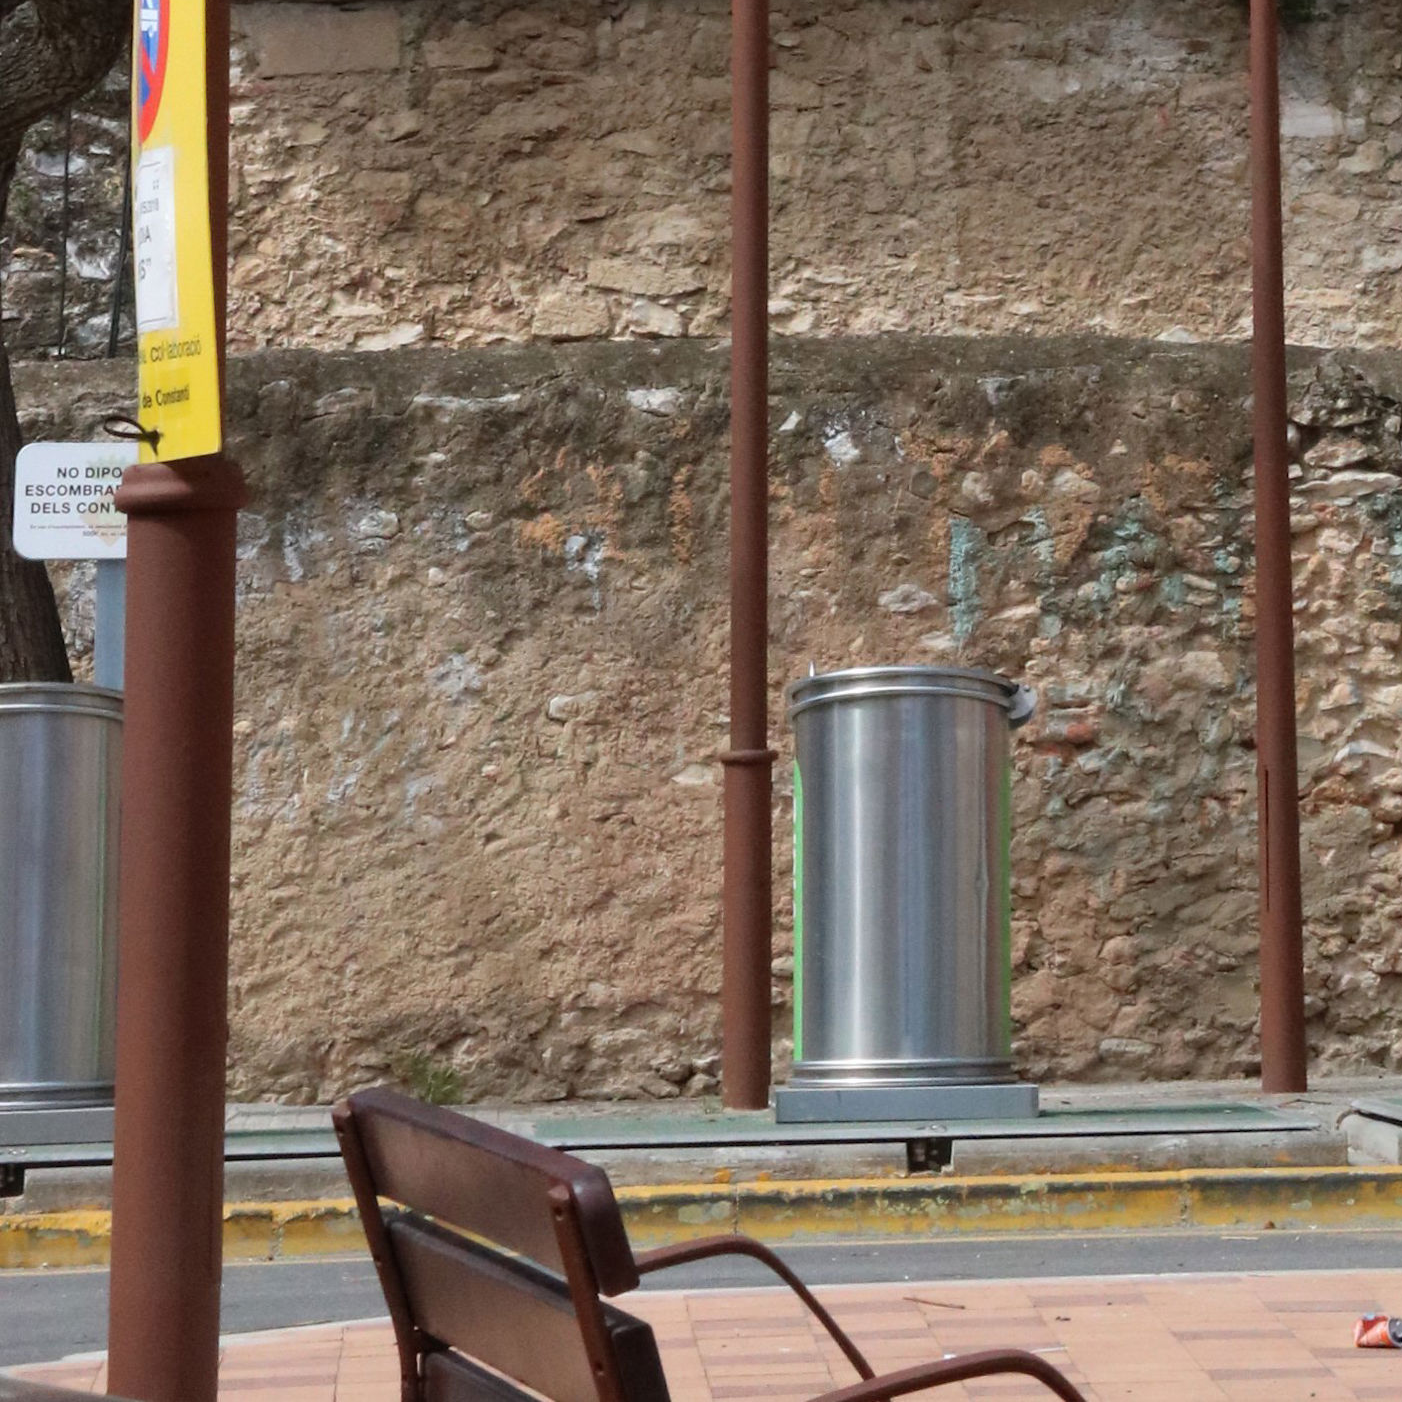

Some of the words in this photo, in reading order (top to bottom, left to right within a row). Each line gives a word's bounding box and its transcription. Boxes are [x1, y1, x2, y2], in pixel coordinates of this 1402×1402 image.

[56, 467, 80, 479] NO
[25, 484, 121, 496] ESCOMBRA
[30, 502, 71, 514] DELS
